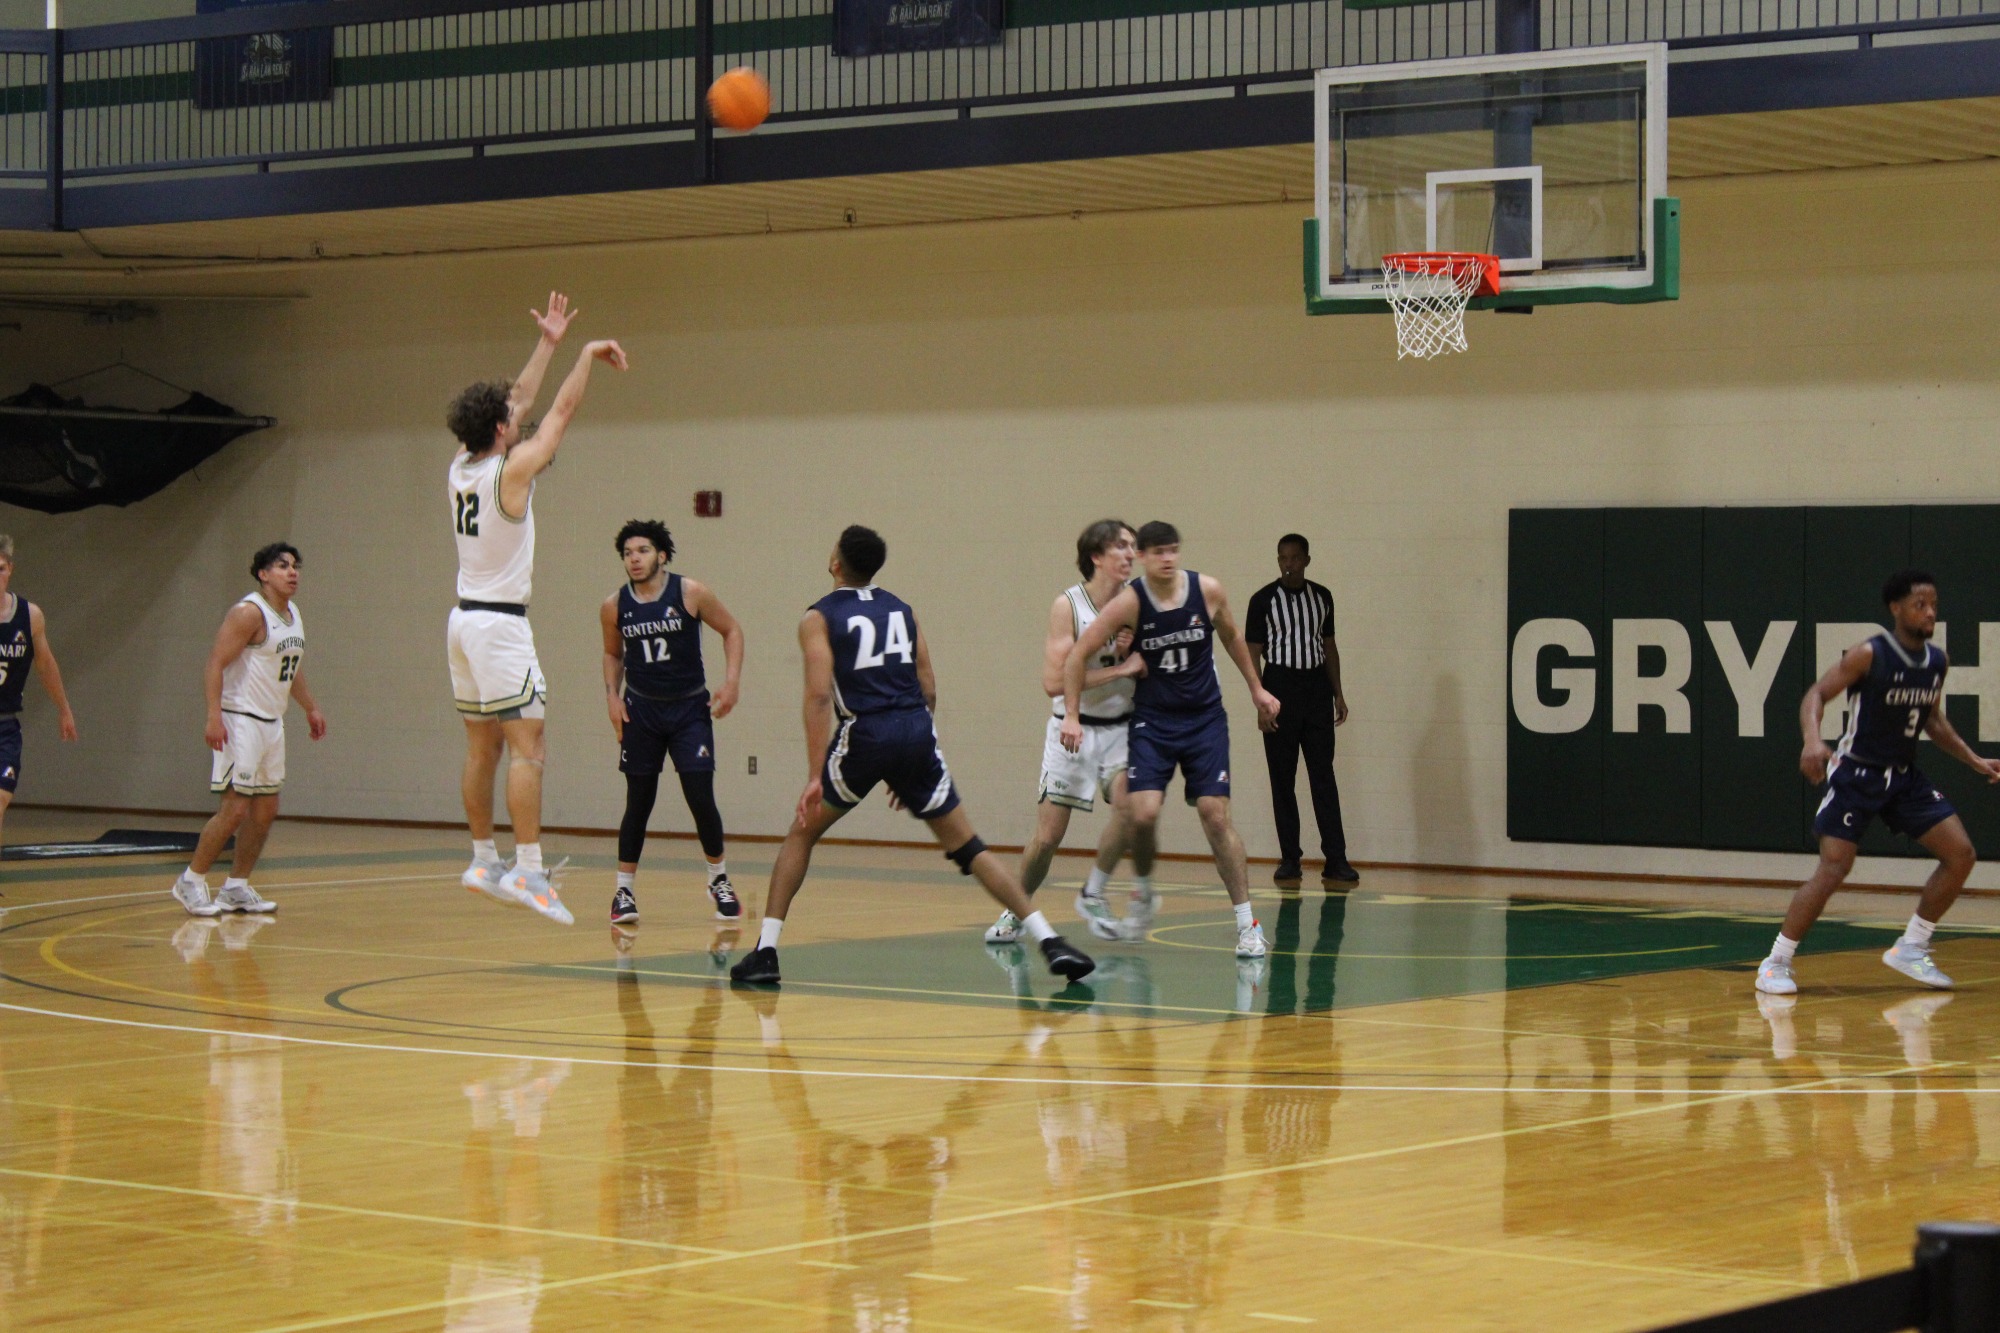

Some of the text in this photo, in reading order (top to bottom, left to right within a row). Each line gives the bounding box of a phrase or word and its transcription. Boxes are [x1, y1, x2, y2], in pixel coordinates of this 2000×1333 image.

[456, 490, 479, 537] 12
[622, 618, 682, 638] CENTENARY
[847, 610, 913, 671] 24
[641, 637, 671, 664] 12
[1159, 647, 1189, 674] 41
[279, 655, 299, 682] 23
[1904, 707, 1921, 738] 3
